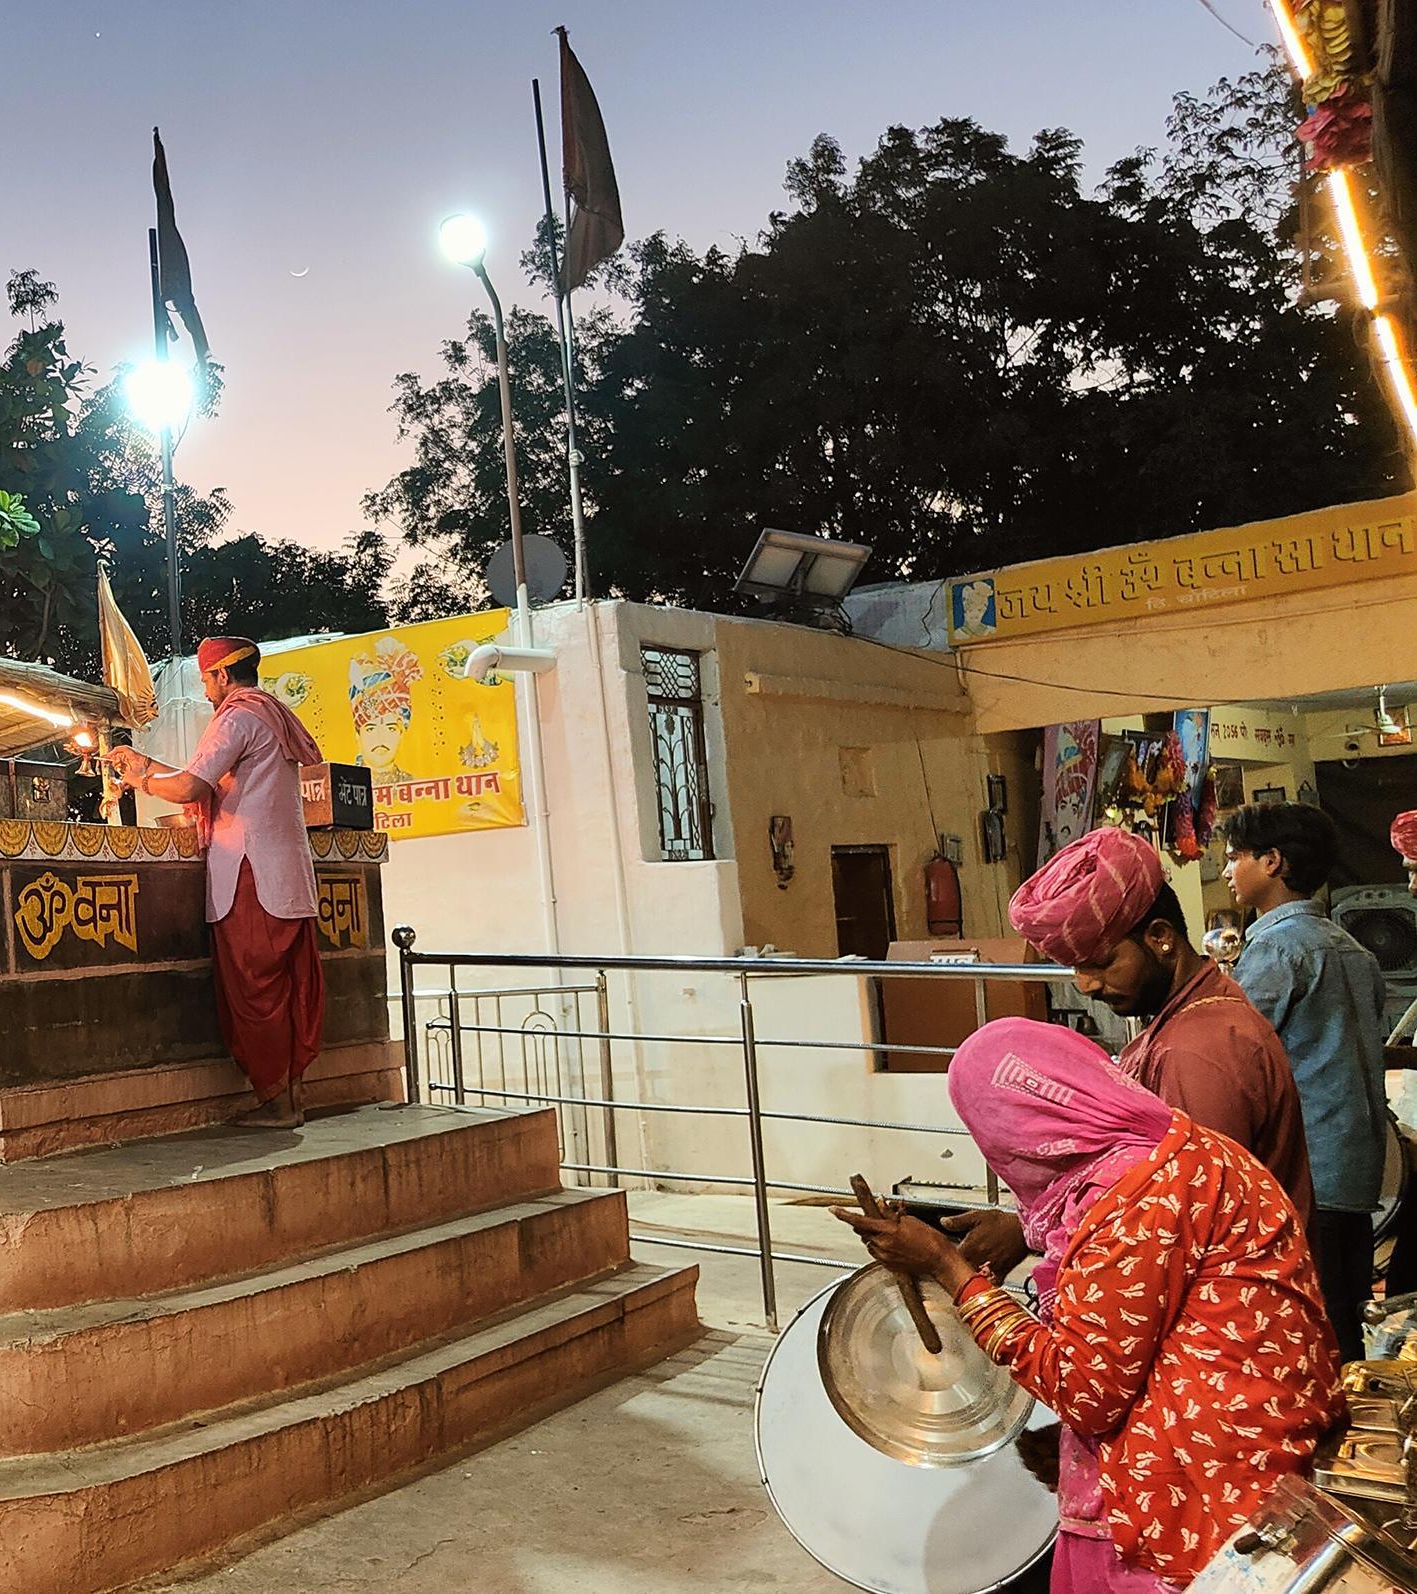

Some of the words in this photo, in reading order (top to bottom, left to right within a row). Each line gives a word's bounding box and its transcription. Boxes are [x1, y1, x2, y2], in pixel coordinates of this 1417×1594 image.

[996, 581, 1059, 620] जय
[1065, 565, 1112, 609] श्री
[1172, 547, 1267, 590] बन्ना
[1271, 537, 1324, 575] सा
[1331, 520, 1415, 563] थान
[352, 784, 368, 807] पात्र
[373, 785, 394, 807] म
[396, 777, 452, 804] बन्ना
[455, 771, 502, 799] थान
[374, 812, 413, 831] टिला
[19, 876, 69, 948] ॐ
